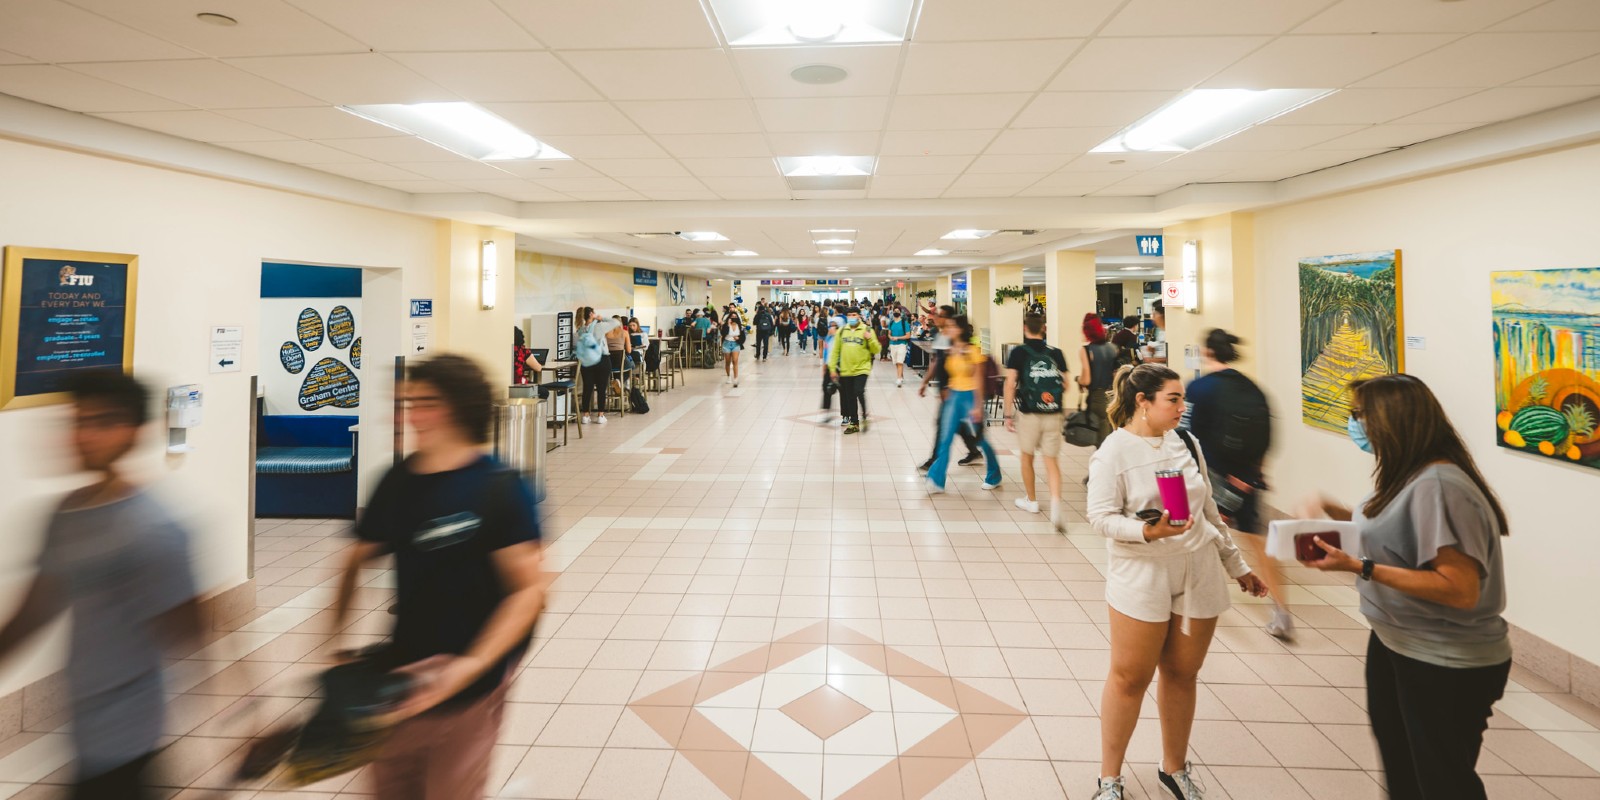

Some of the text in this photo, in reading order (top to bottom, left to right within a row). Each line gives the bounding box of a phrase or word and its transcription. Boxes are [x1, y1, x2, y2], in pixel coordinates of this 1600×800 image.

[69, 275, 94, 286] FIU
[48, 292, 79, 300] TODAY
[41, 300, 70, 308] EVERY
[330, 321, 351, 331] Loyalty
[299, 330, 318, 339] Family
[44, 335, 75, 343] graduate
[36, 353, 70, 362] employed
[325, 365, 341, 373] Team
[315, 374, 331, 382] Trust
[300, 391, 331, 404] Graham
[332, 383, 359, 396] Center
